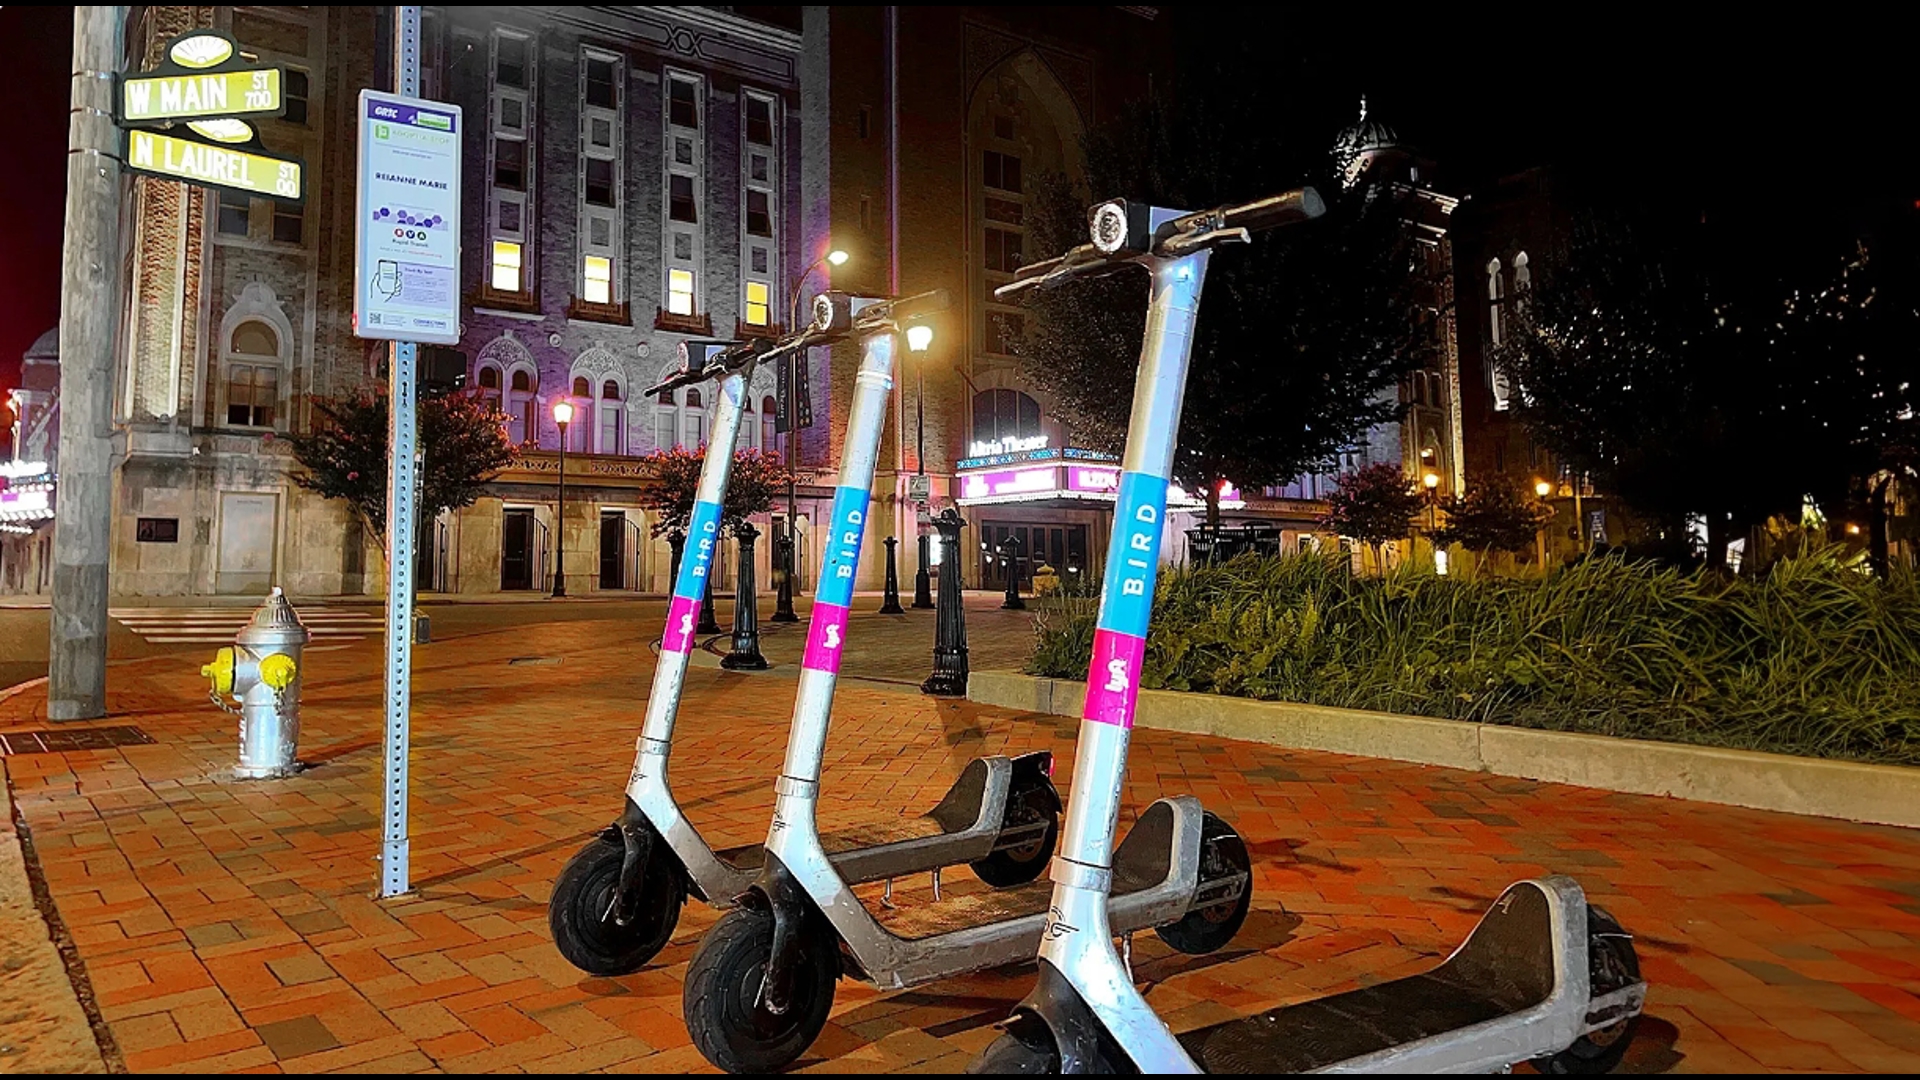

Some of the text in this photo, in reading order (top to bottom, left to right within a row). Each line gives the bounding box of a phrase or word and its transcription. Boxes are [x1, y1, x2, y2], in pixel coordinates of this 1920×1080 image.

[129, 71, 270, 114] W MAIN ST
[245, 90, 272, 109] 700
[135, 134, 297, 186] N LAUREL ST
[276, 178, 296, 197] 00
[419, 179, 448, 190] MARIE
[692, 520, 717, 578] BIRD
[837, 509, 863, 579] BIRD
[1122, 504, 1157, 597] BIRD
